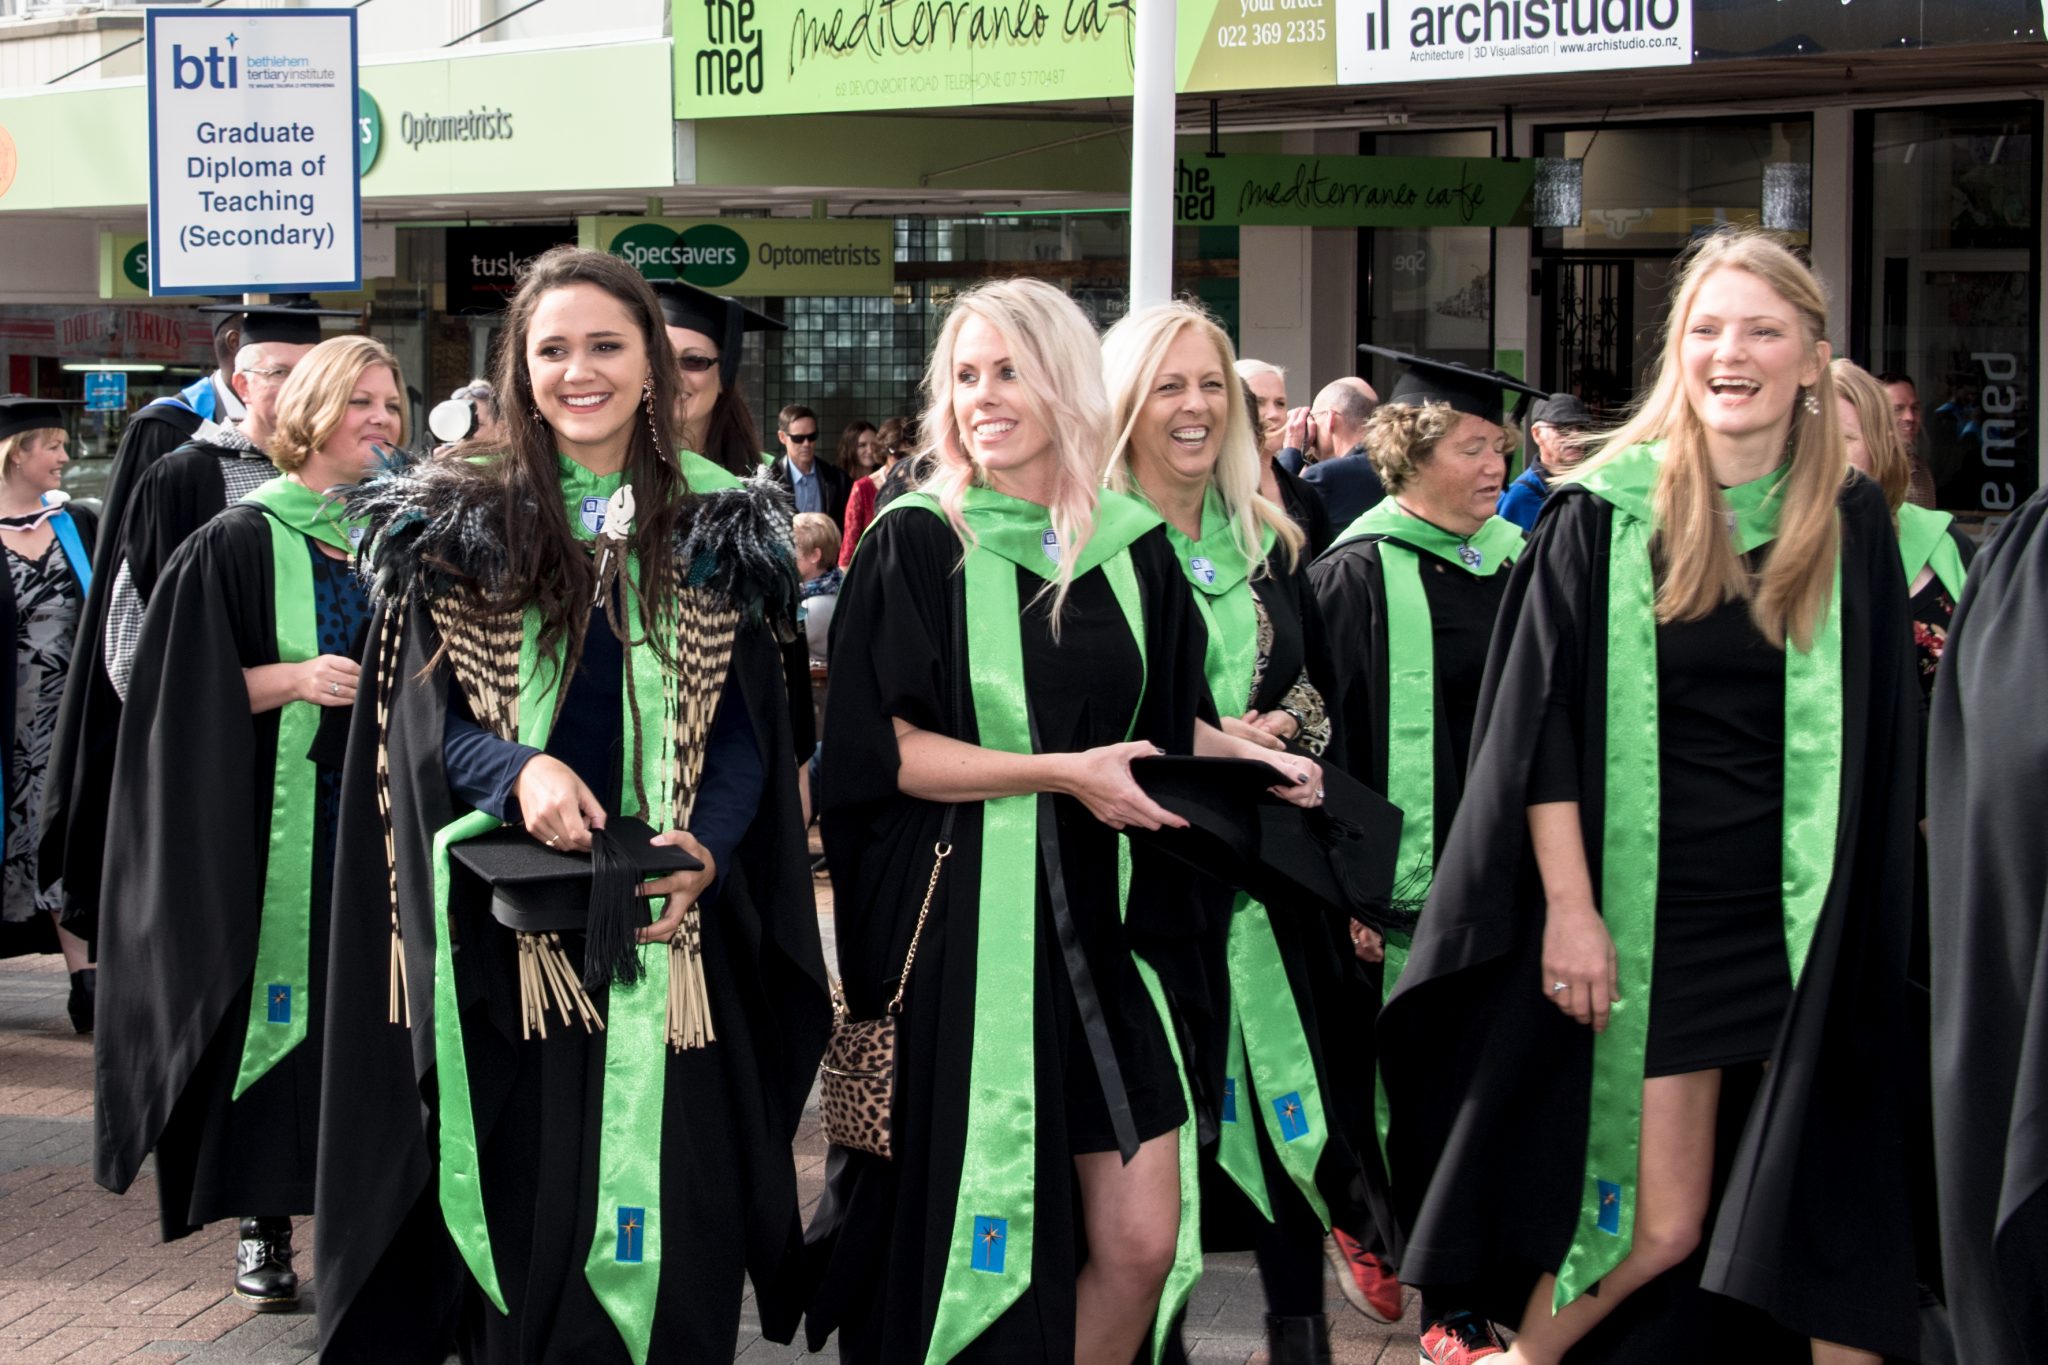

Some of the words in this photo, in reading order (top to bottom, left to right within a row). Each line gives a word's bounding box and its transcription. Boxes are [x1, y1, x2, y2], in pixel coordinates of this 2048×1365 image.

[704, 0, 756, 45] the
[790, 0, 1050, 76] mediterraneo
[1218, 26, 1247, 48] 022
[1252, 22, 1281, 46] 369
[1286, 18, 1327, 43] 2335
[1409, 0, 1680, 48] archistudio
[247, 55, 309, 67] bethlehem
[696, 29, 764, 96] med
[1410, 48, 1464, 62] Architecture
[1474, 46, 1488, 59] 3D
[1490, 43, 1550, 57] Visualisation
[1560, 36, 1678, 54] www.archistudio.co.nz
[172, 44, 238, 90] bti
[910, 75, 939, 92] ROAD
[944, 71, 1001, 90] TELEPHONE
[1004, 71, 1017, 88] 07
[1020, 69, 1065, 87] 5770487
[196, 121, 315, 144] Graduate
[401, 105, 514, 151] Optometrists
[187, 156, 293, 183] Diploma
[301, 154, 326, 176] of
[1174, 158, 1210, 193] he
[198, 189, 315, 216] Teaching
[1237, 160, 1418, 218] mediterraneo
[1426, 162, 1487, 223] cafe
[179, 222, 335, 253] (Secondary)
[622, 241, 736, 269] Specsavers
[758, 242, 881, 270] Optometrists
